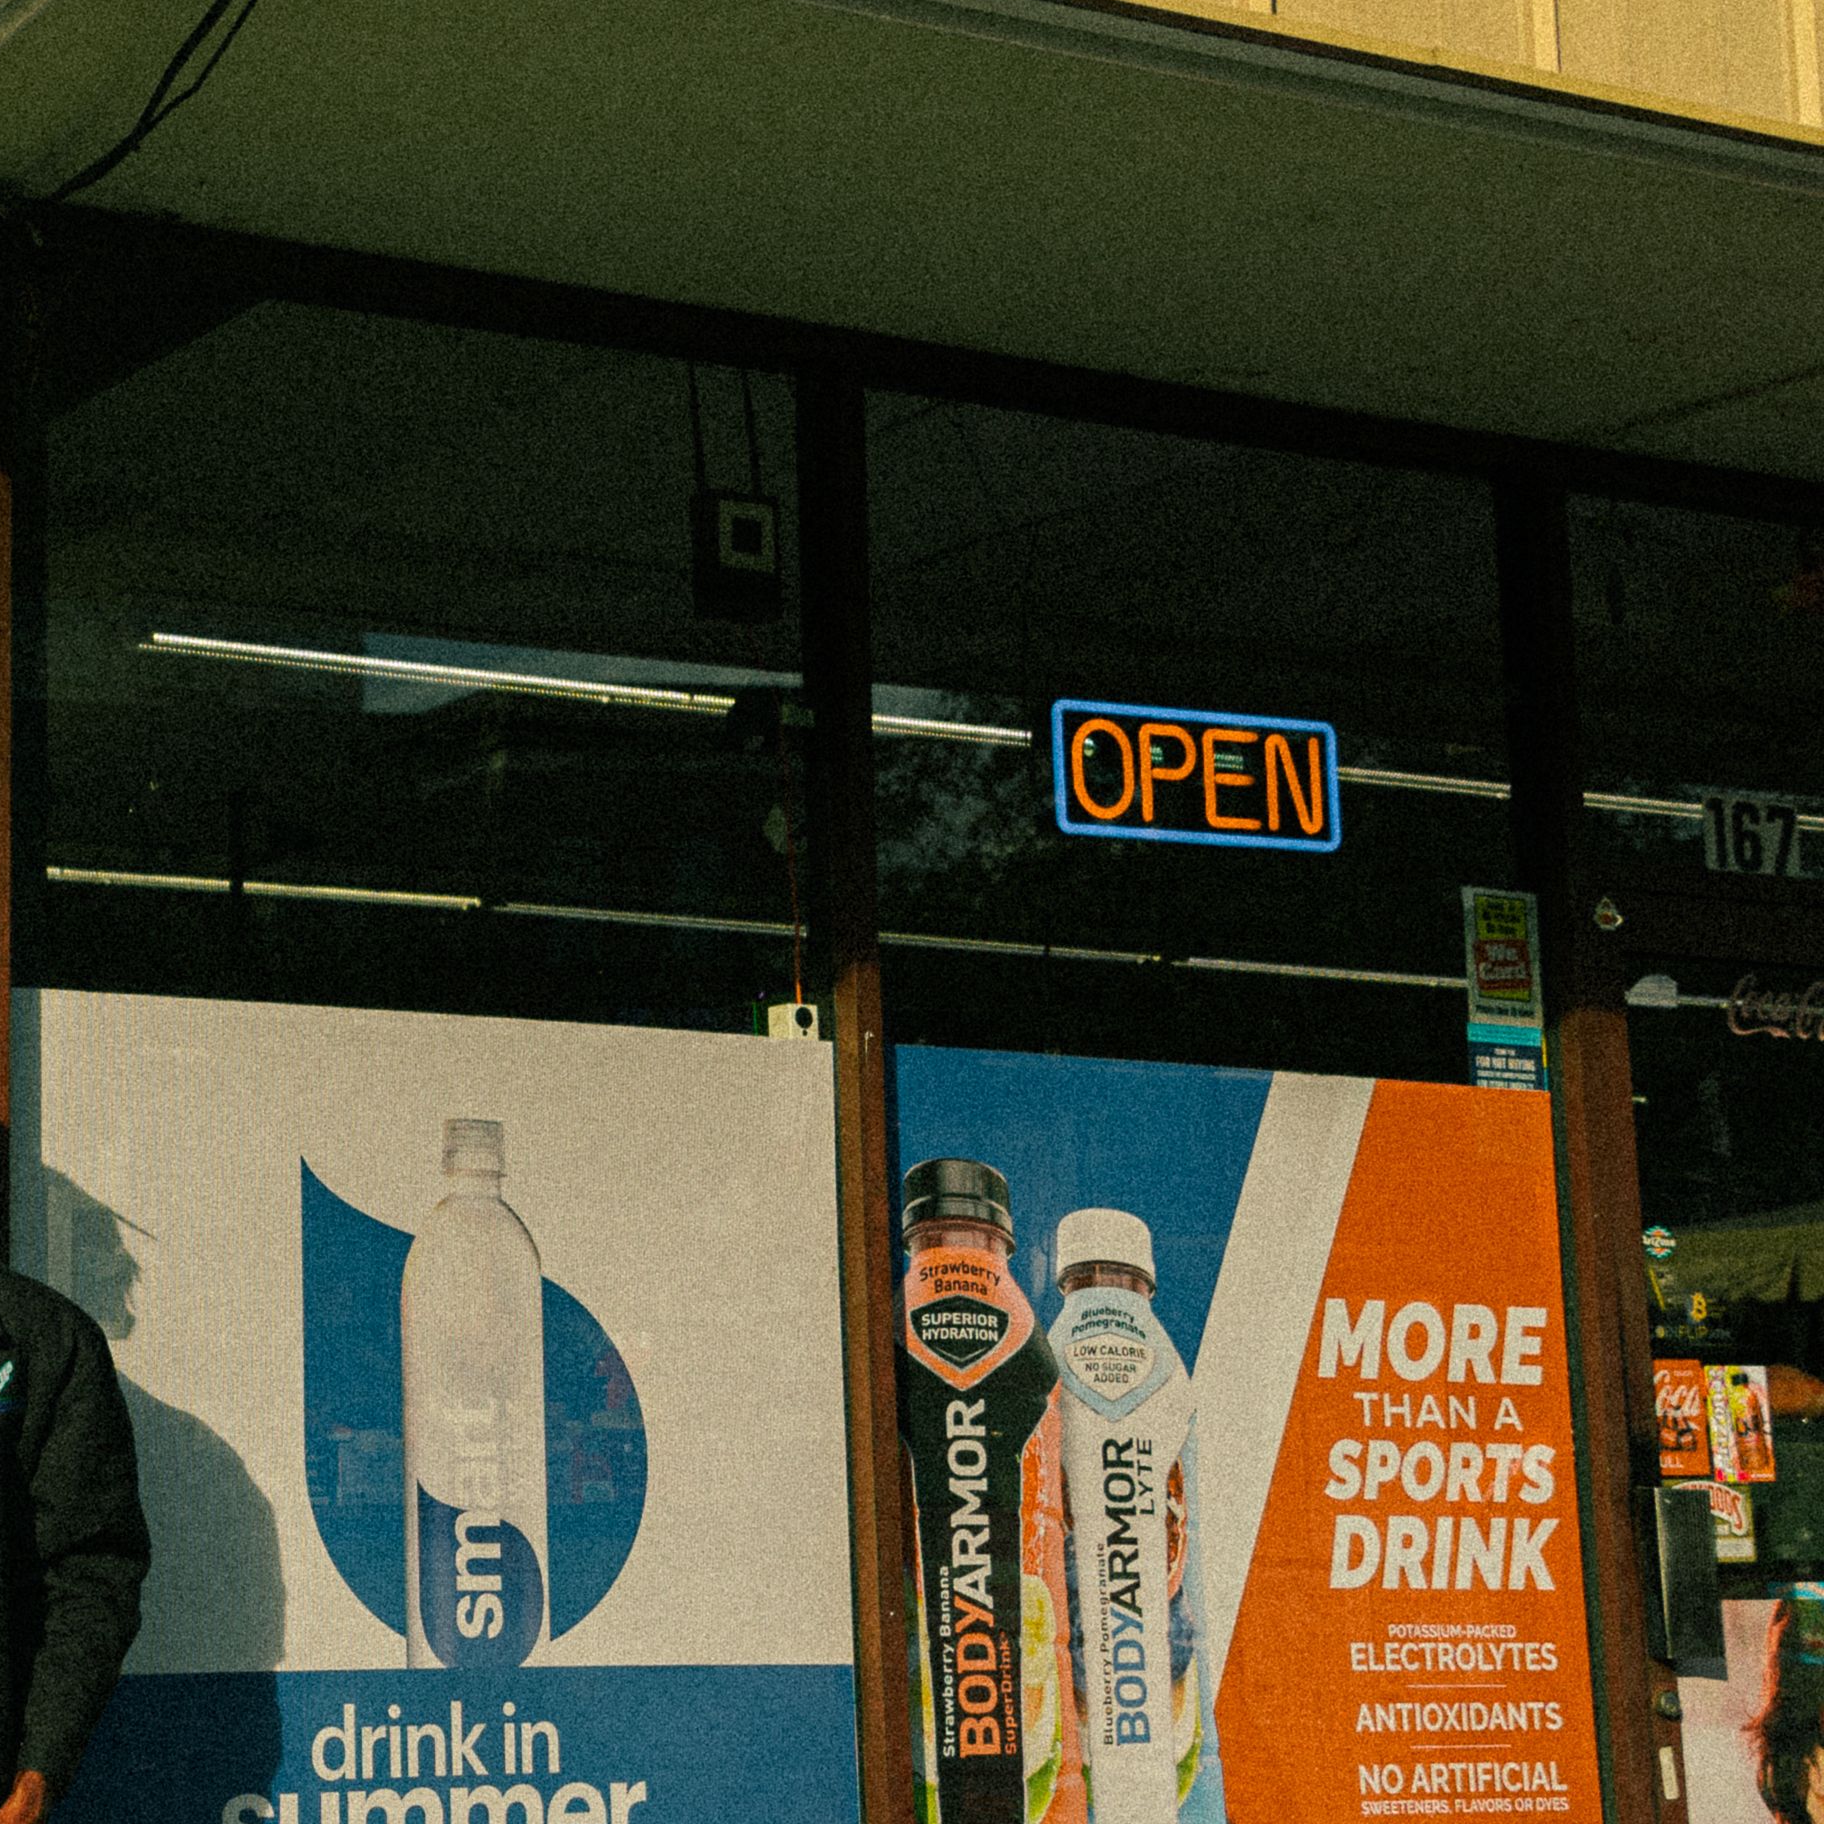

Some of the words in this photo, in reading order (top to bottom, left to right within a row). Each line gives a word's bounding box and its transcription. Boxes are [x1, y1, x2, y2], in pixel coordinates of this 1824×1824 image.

[1071, 717, 1323, 835] OPEN
[919, 1260, 1001, 1287] Strawberry
[934, 1278, 989, 1296] Banana
[921, 1311, 999, 1328] SUPERIOR
[1071, 1318, 1147, 1339] Pomegranate
[1081, 1306, 1135, 1324] Blueberry
[921, 1327, 999, 1342] HYDRATION
[1318, 1297, 1547, 1386] MORE
[1074, 1345, 1097, 1358] LOW
[1099, 1345, 1147, 1360] CALORIE
[1085, 1362, 1100, 1372] NO
[1102, 1362, 1137, 1373] SUGAR
[1093, 1374, 1130, 1384] ADDED
[1353, 1391, 1476, 1429] THAN
[1494, 1396, 1524, 1432] A
[1136, 1439, 1155, 1516] LYTE
[1324, 1438, 1556, 1504] SPORTS
[1329, 1514, 1560, 1591] DRINK
[945, 1398, 1003, 1759] BODYARMOR
[1101, 1437, 1152, 1746] BODYARMOR
[939, 1565, 952, 1637] Banana
[1097, 1542, 1110, 1653] Pomegranate
[1387, 1624, 1517, 1638] POTASSIUM-PACKED
[1350, 1642, 1559, 1672] ELECTROLYTES
[942, 1643, 957, 1758] Strawberry
[1102, 1656, 1114, 1746] Blueberry
[1355, 1701, 1564, 1733] ANTIOXIDANTS
[311, 1700, 489, 1782] drink
[502, 1701, 561, 1776] in
[1358, 1763, 1404, 1795] NO
[1411, 1761, 1569, 1794] ARTIFICIAL
[1361, 1799, 1452, 1816] SWEETENERS,
[1455, 1797, 1512, 1813] FLAVORS
[1515, 1796, 1534, 1812] OR
[1537, 1796, 1570, 1812] DYES
